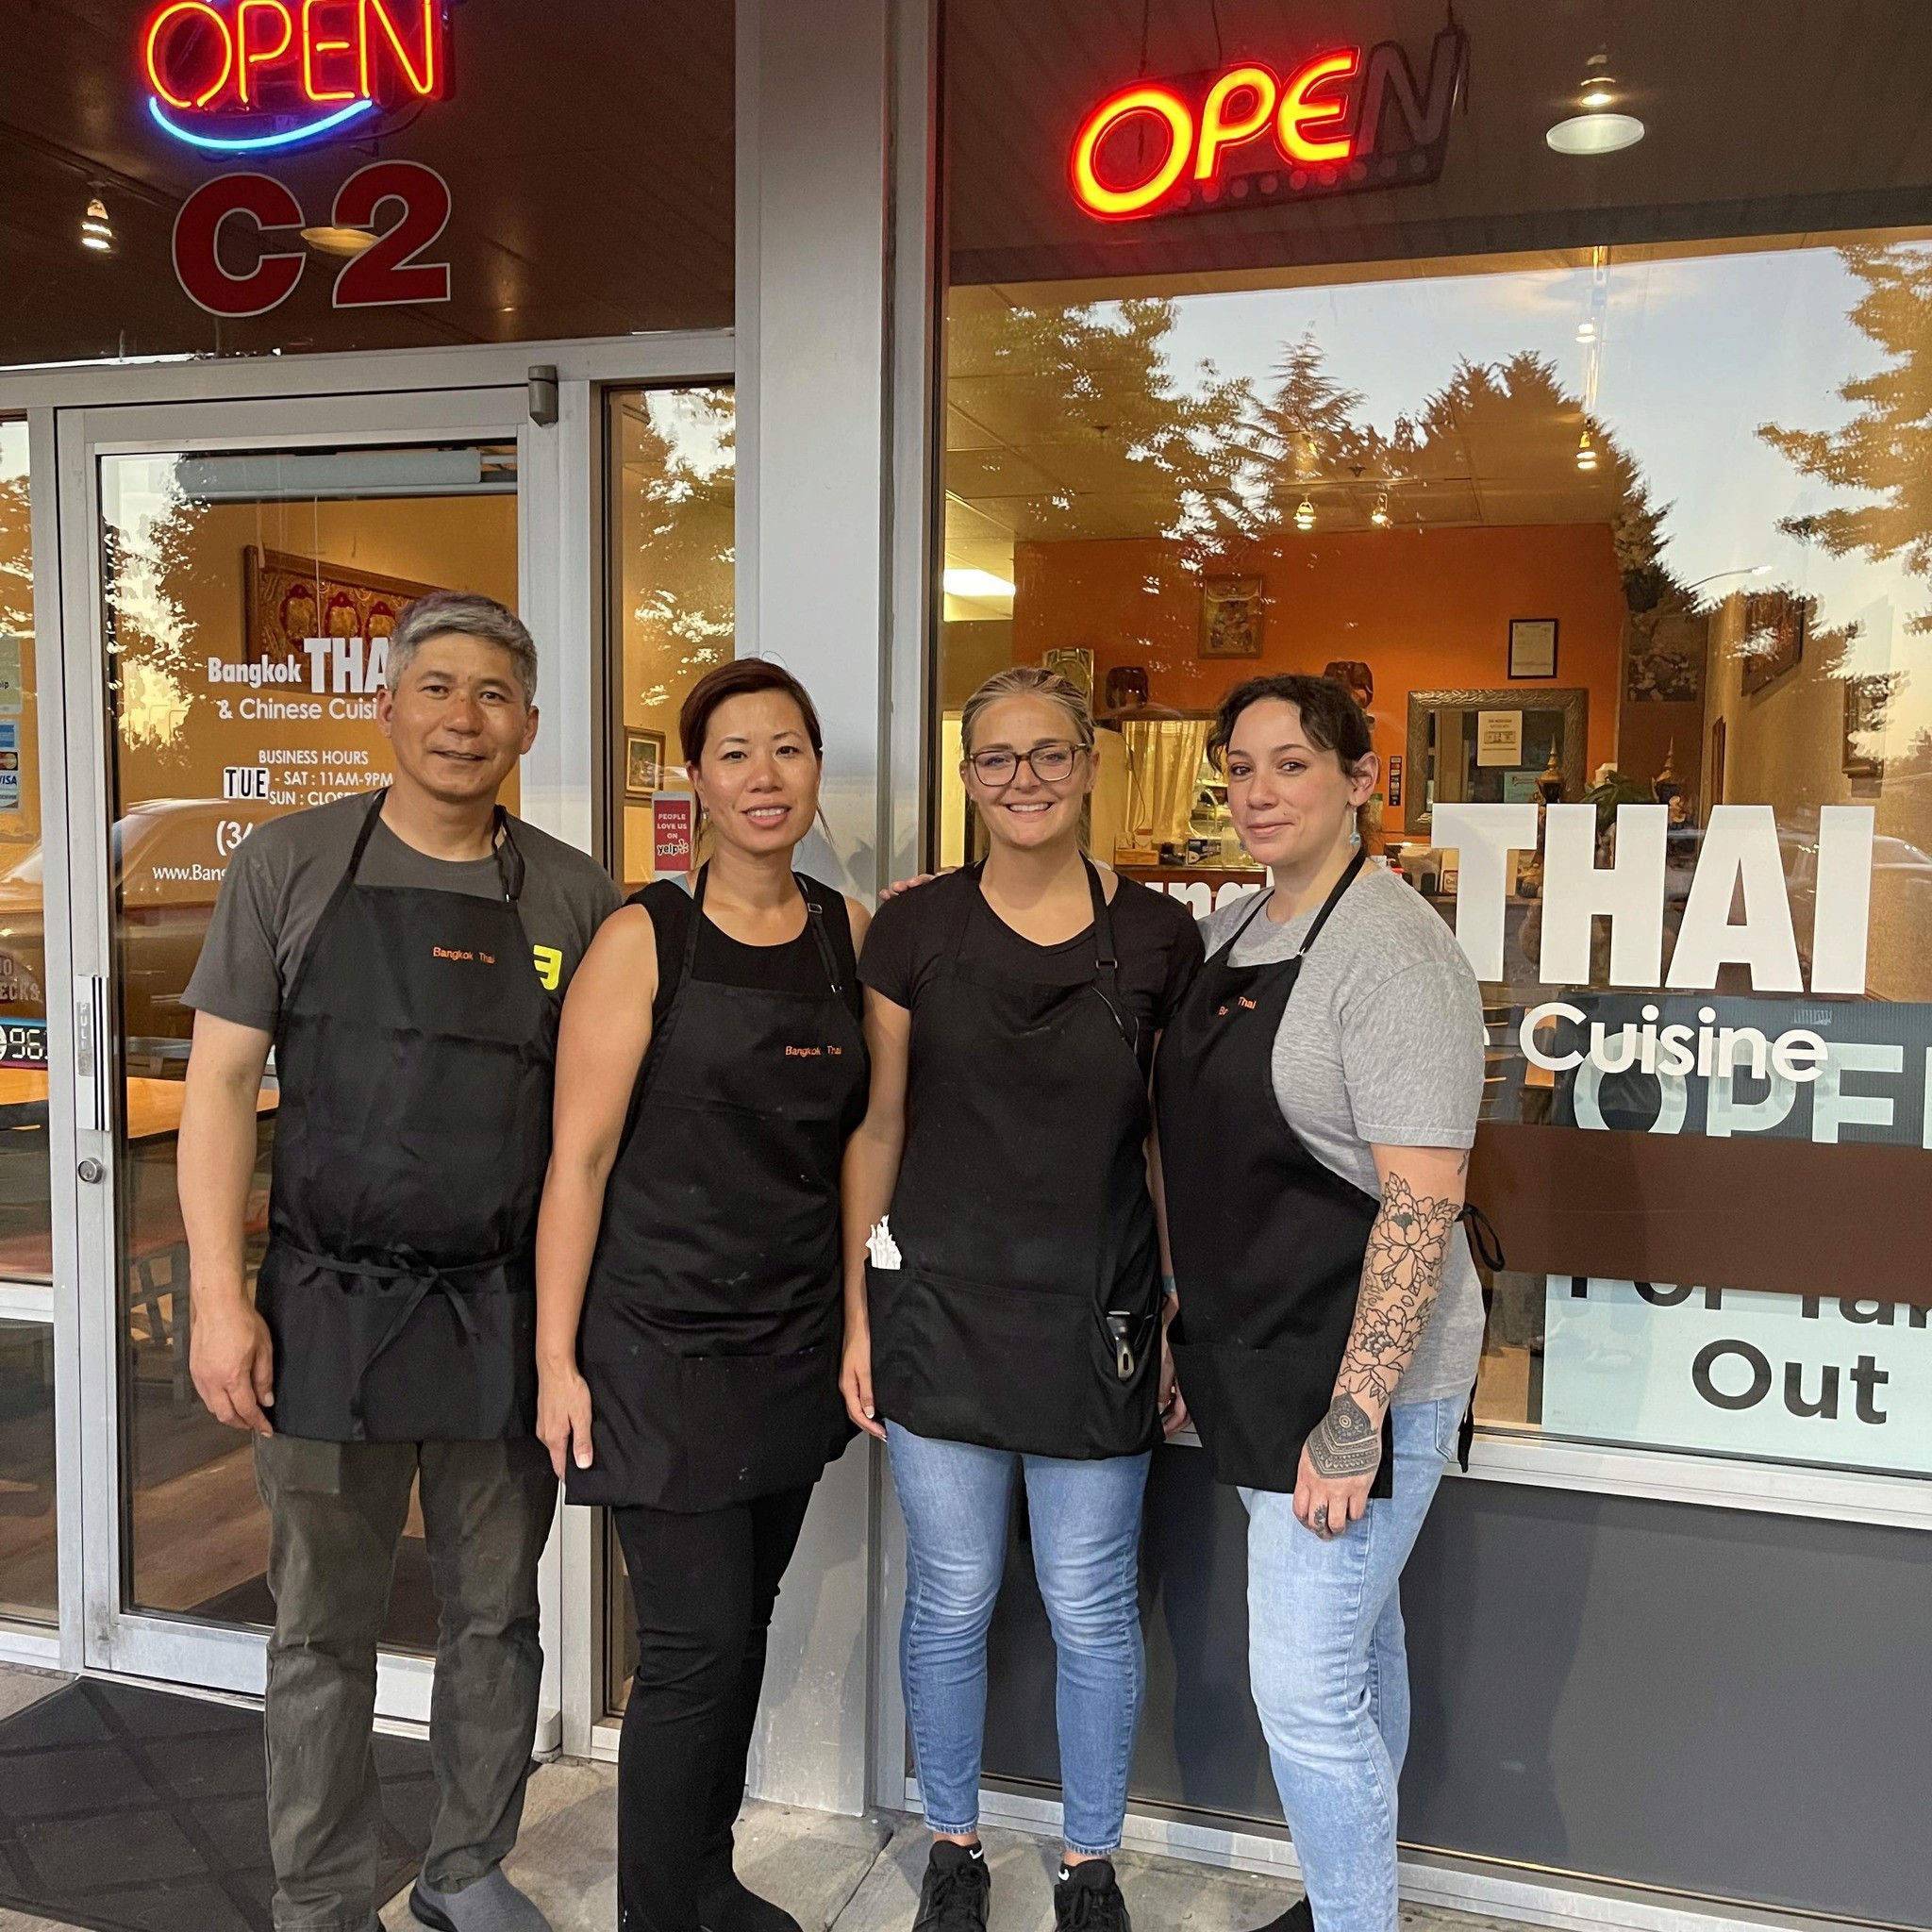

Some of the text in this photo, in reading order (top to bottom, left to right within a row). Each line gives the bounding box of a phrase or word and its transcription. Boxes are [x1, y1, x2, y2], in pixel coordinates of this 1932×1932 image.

[146, 0, 436, 108] OPEN
[1071, 30, 1464, 219] OPEN
[173, 159, 452, 317] C2
[208, 638, 389, 693] Bangkok THA
[219, 697, 377, 720] & Chinese Cuisi
[258, 750, 369, 765] BUSINESS HOURS
[225, 768, 267, 797] TUE
[284, 772, 308, 786] SAT
[320, 772, 394, 787] 11AM-9PM
[270, 791, 296, 805] SUN
[658, 842, 678, 856] yelp
[1431, 803, 1875, 994] THAI
[433, 946, 495, 964] Bangkok Thai
[785, 1045, 842, 1058] Bangkok Thai
[1520, 1002, 1828, 1083] Cuisine
[1691, 1339, 1890, 1424] Out
